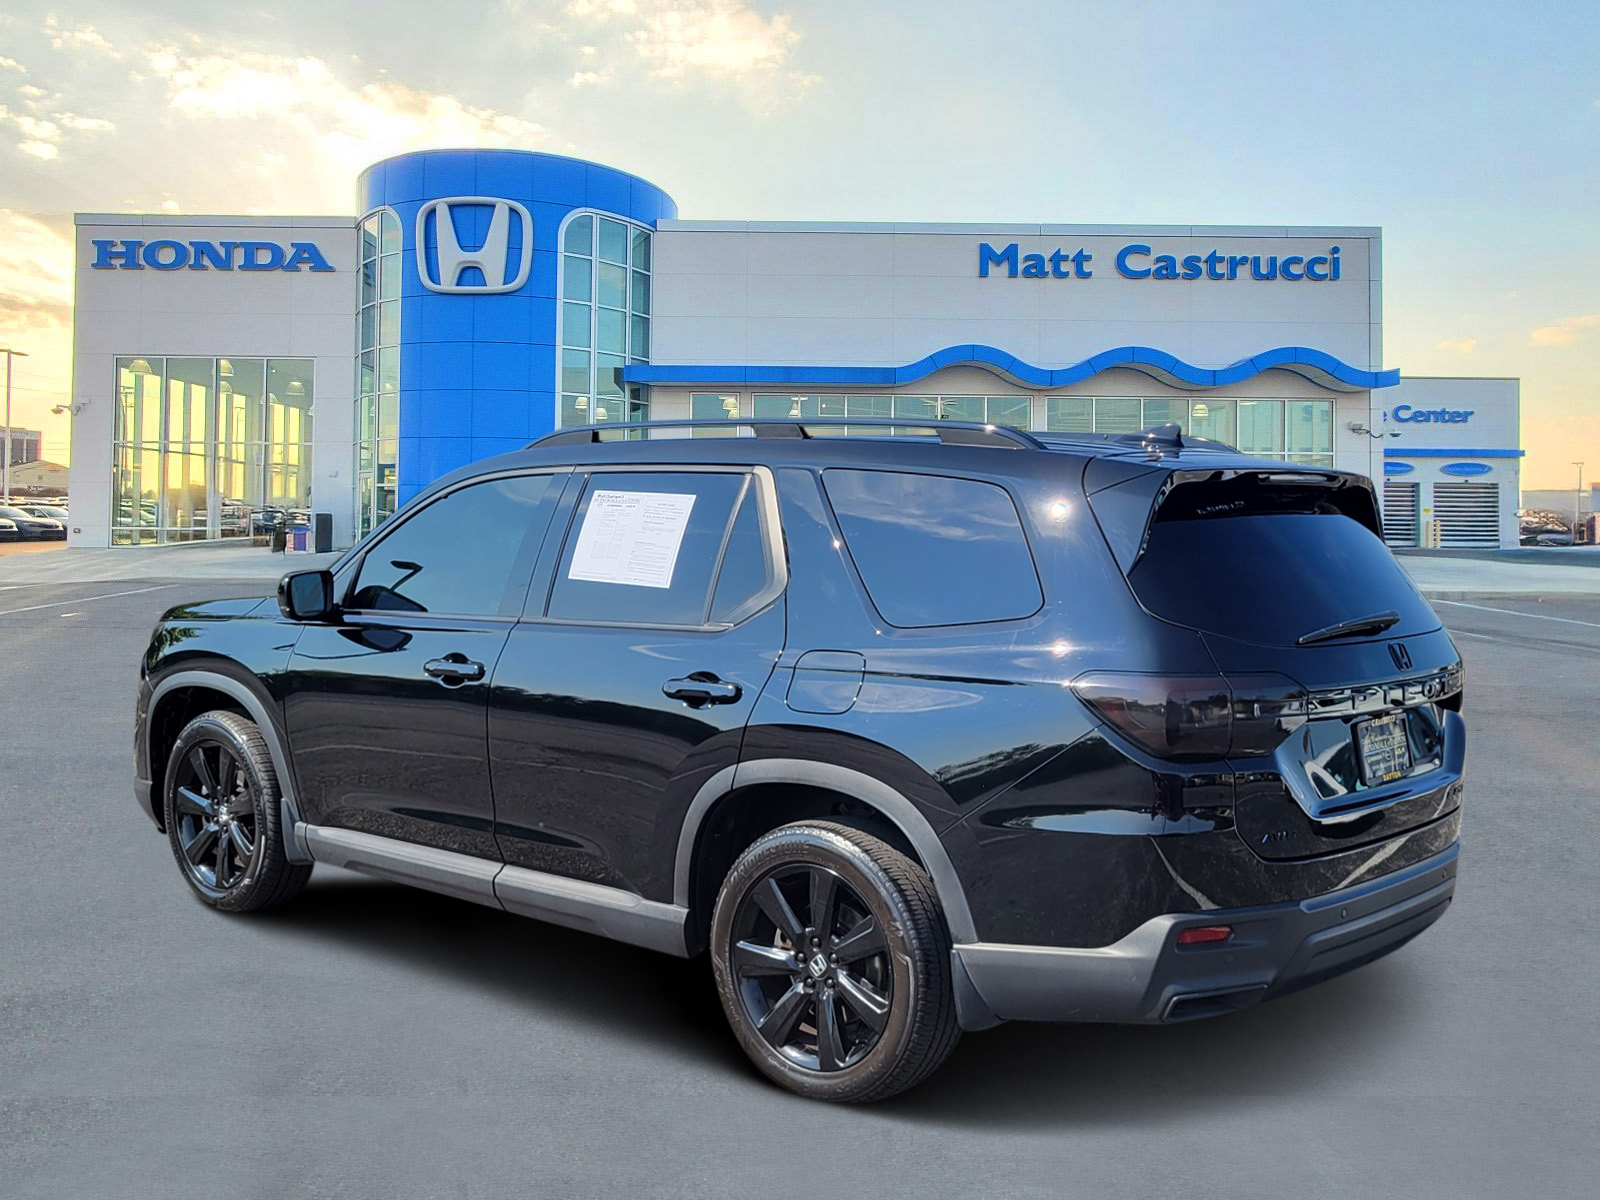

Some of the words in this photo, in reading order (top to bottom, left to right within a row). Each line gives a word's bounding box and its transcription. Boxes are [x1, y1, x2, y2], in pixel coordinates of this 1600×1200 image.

[91, 239, 336, 272] HONDA
[978, 242, 1092, 278] Matt
[1115, 244, 1341, 280] Castrucci
[1391, 405, 1475, 424] Center
[1351, 675, 1451, 711] PILOT
